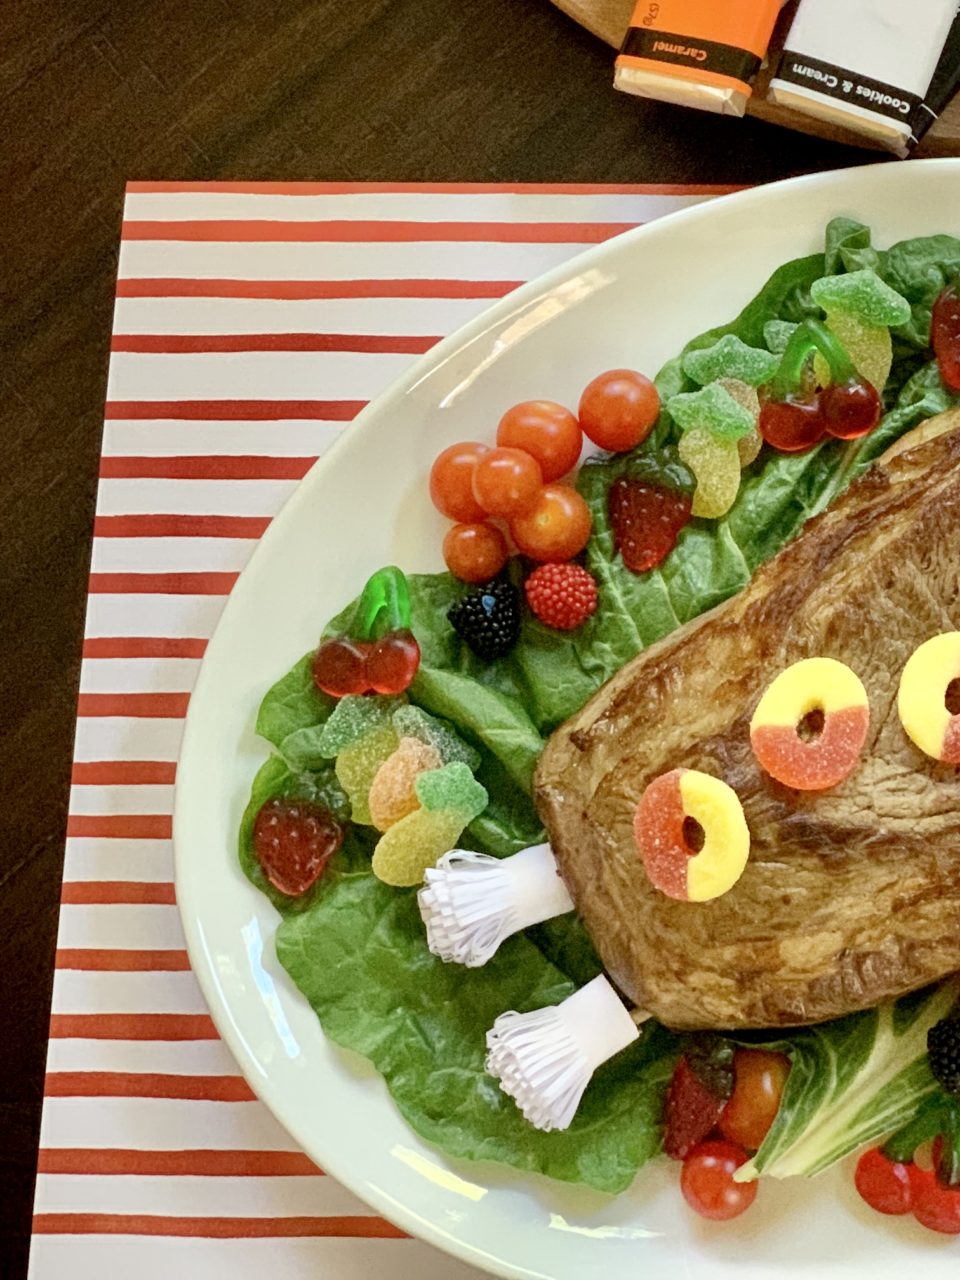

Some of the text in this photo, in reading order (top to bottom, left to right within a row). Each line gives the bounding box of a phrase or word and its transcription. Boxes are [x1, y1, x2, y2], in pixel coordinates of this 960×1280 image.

[652, 41, 707, 61] Caramel
[792, 63, 910, 114] Cookies & Cream
